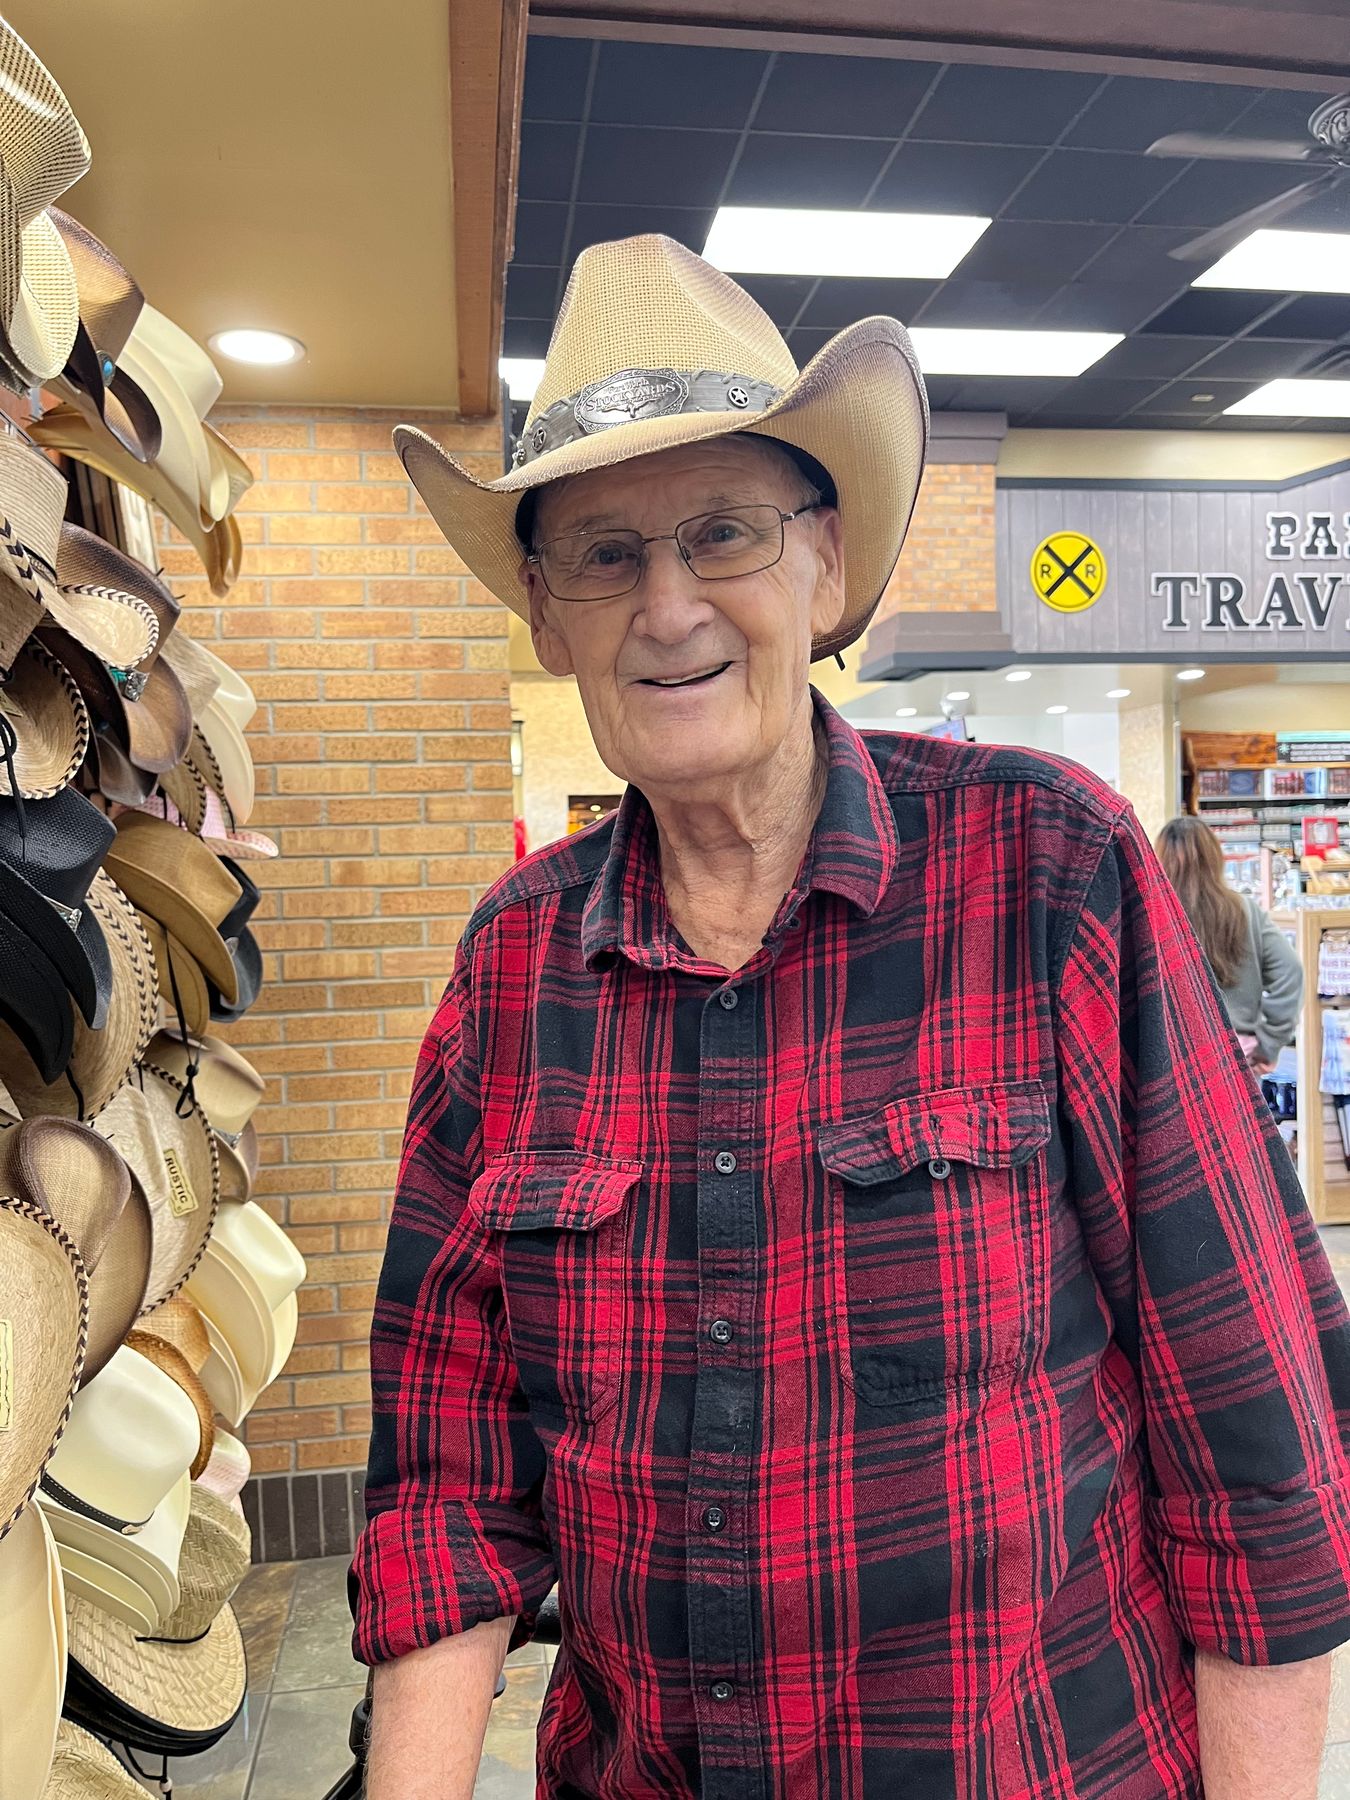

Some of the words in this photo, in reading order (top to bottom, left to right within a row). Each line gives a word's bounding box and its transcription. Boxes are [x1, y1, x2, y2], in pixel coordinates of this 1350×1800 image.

[585, 381, 676, 412] STOCKYARDS
[1268, 512, 1350, 559] PA
[1041, 563, 1052, 579] R
[1085, 563, 1097, 578] R
[1152, 573, 1350, 631] TRAV
[165, 1157, 187, 1203] RUSTIC
